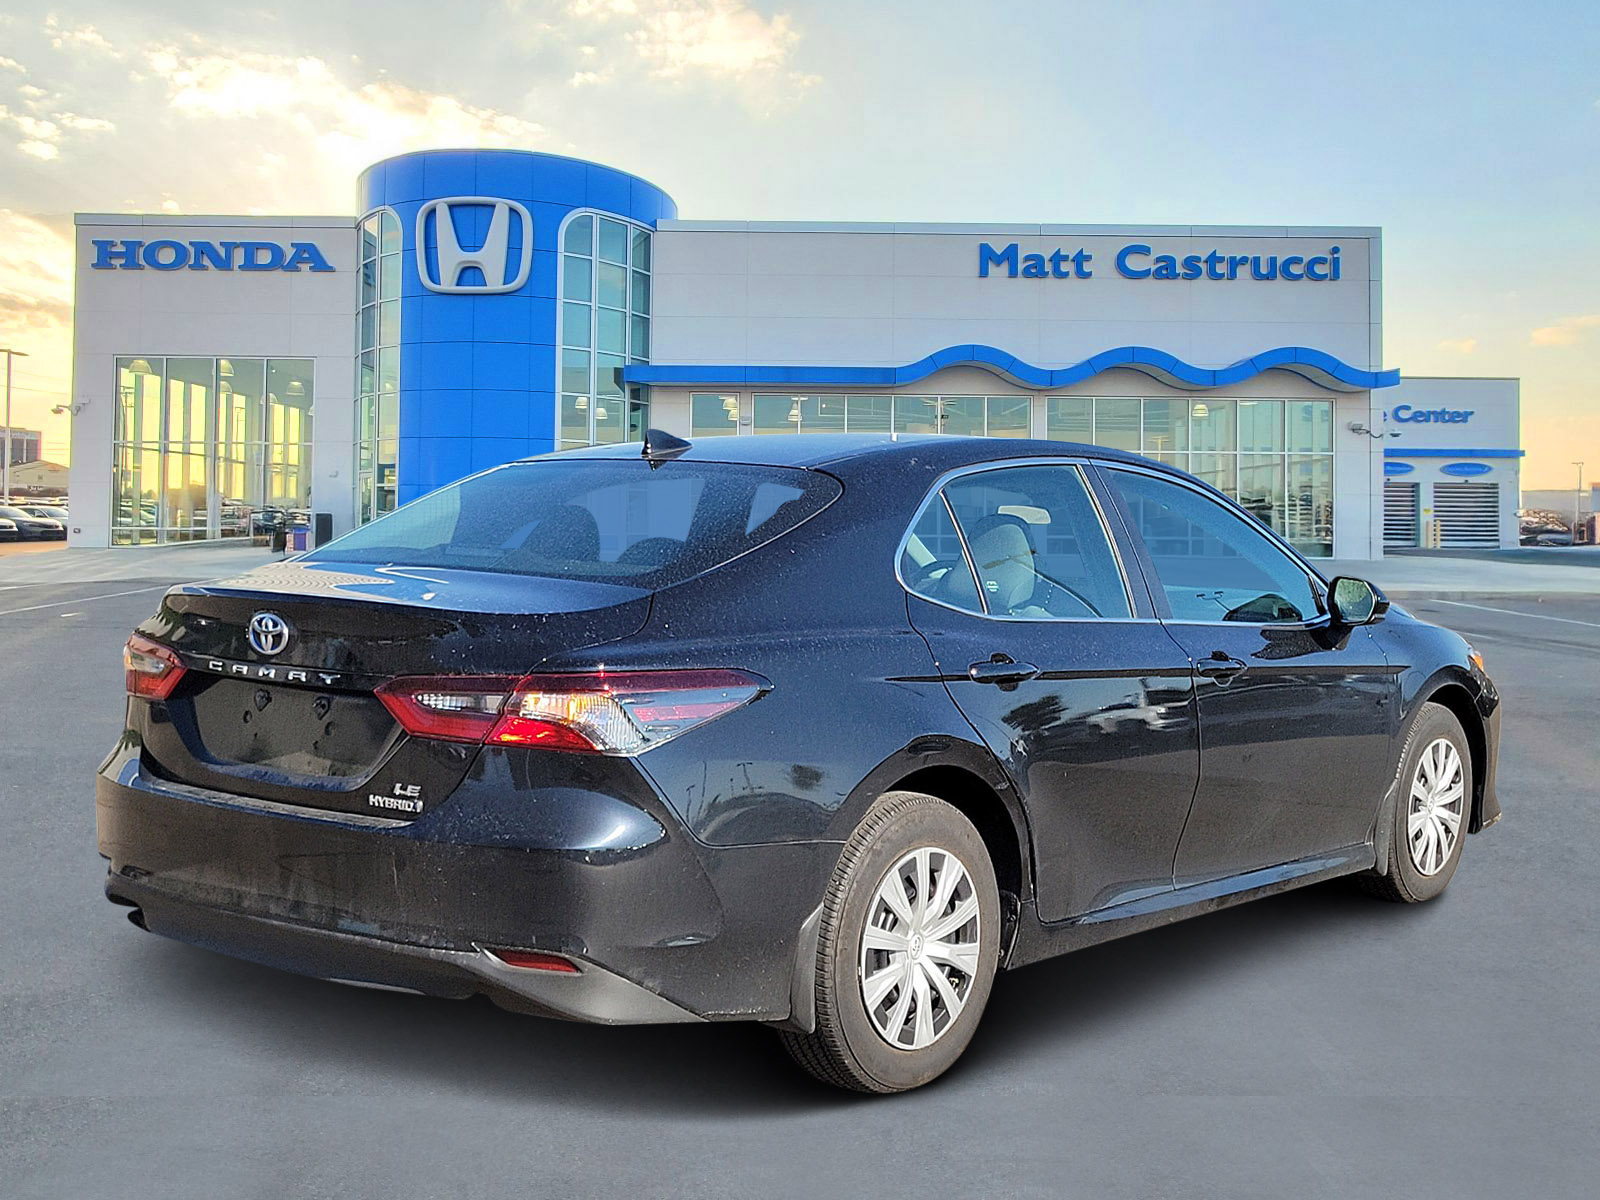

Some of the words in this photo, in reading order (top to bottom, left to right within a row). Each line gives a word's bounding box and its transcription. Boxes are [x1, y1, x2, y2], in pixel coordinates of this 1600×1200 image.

[91, 239, 336, 272] HONDA
[979, 242, 1093, 279] Matt
[1115, 244, 1342, 281] Castrucci
[1392, 404, 1475, 424] Center
[208, 660, 341, 685] CAMRY
[393, 782, 421, 797] LE
[368, 794, 415, 812] HYBRID
